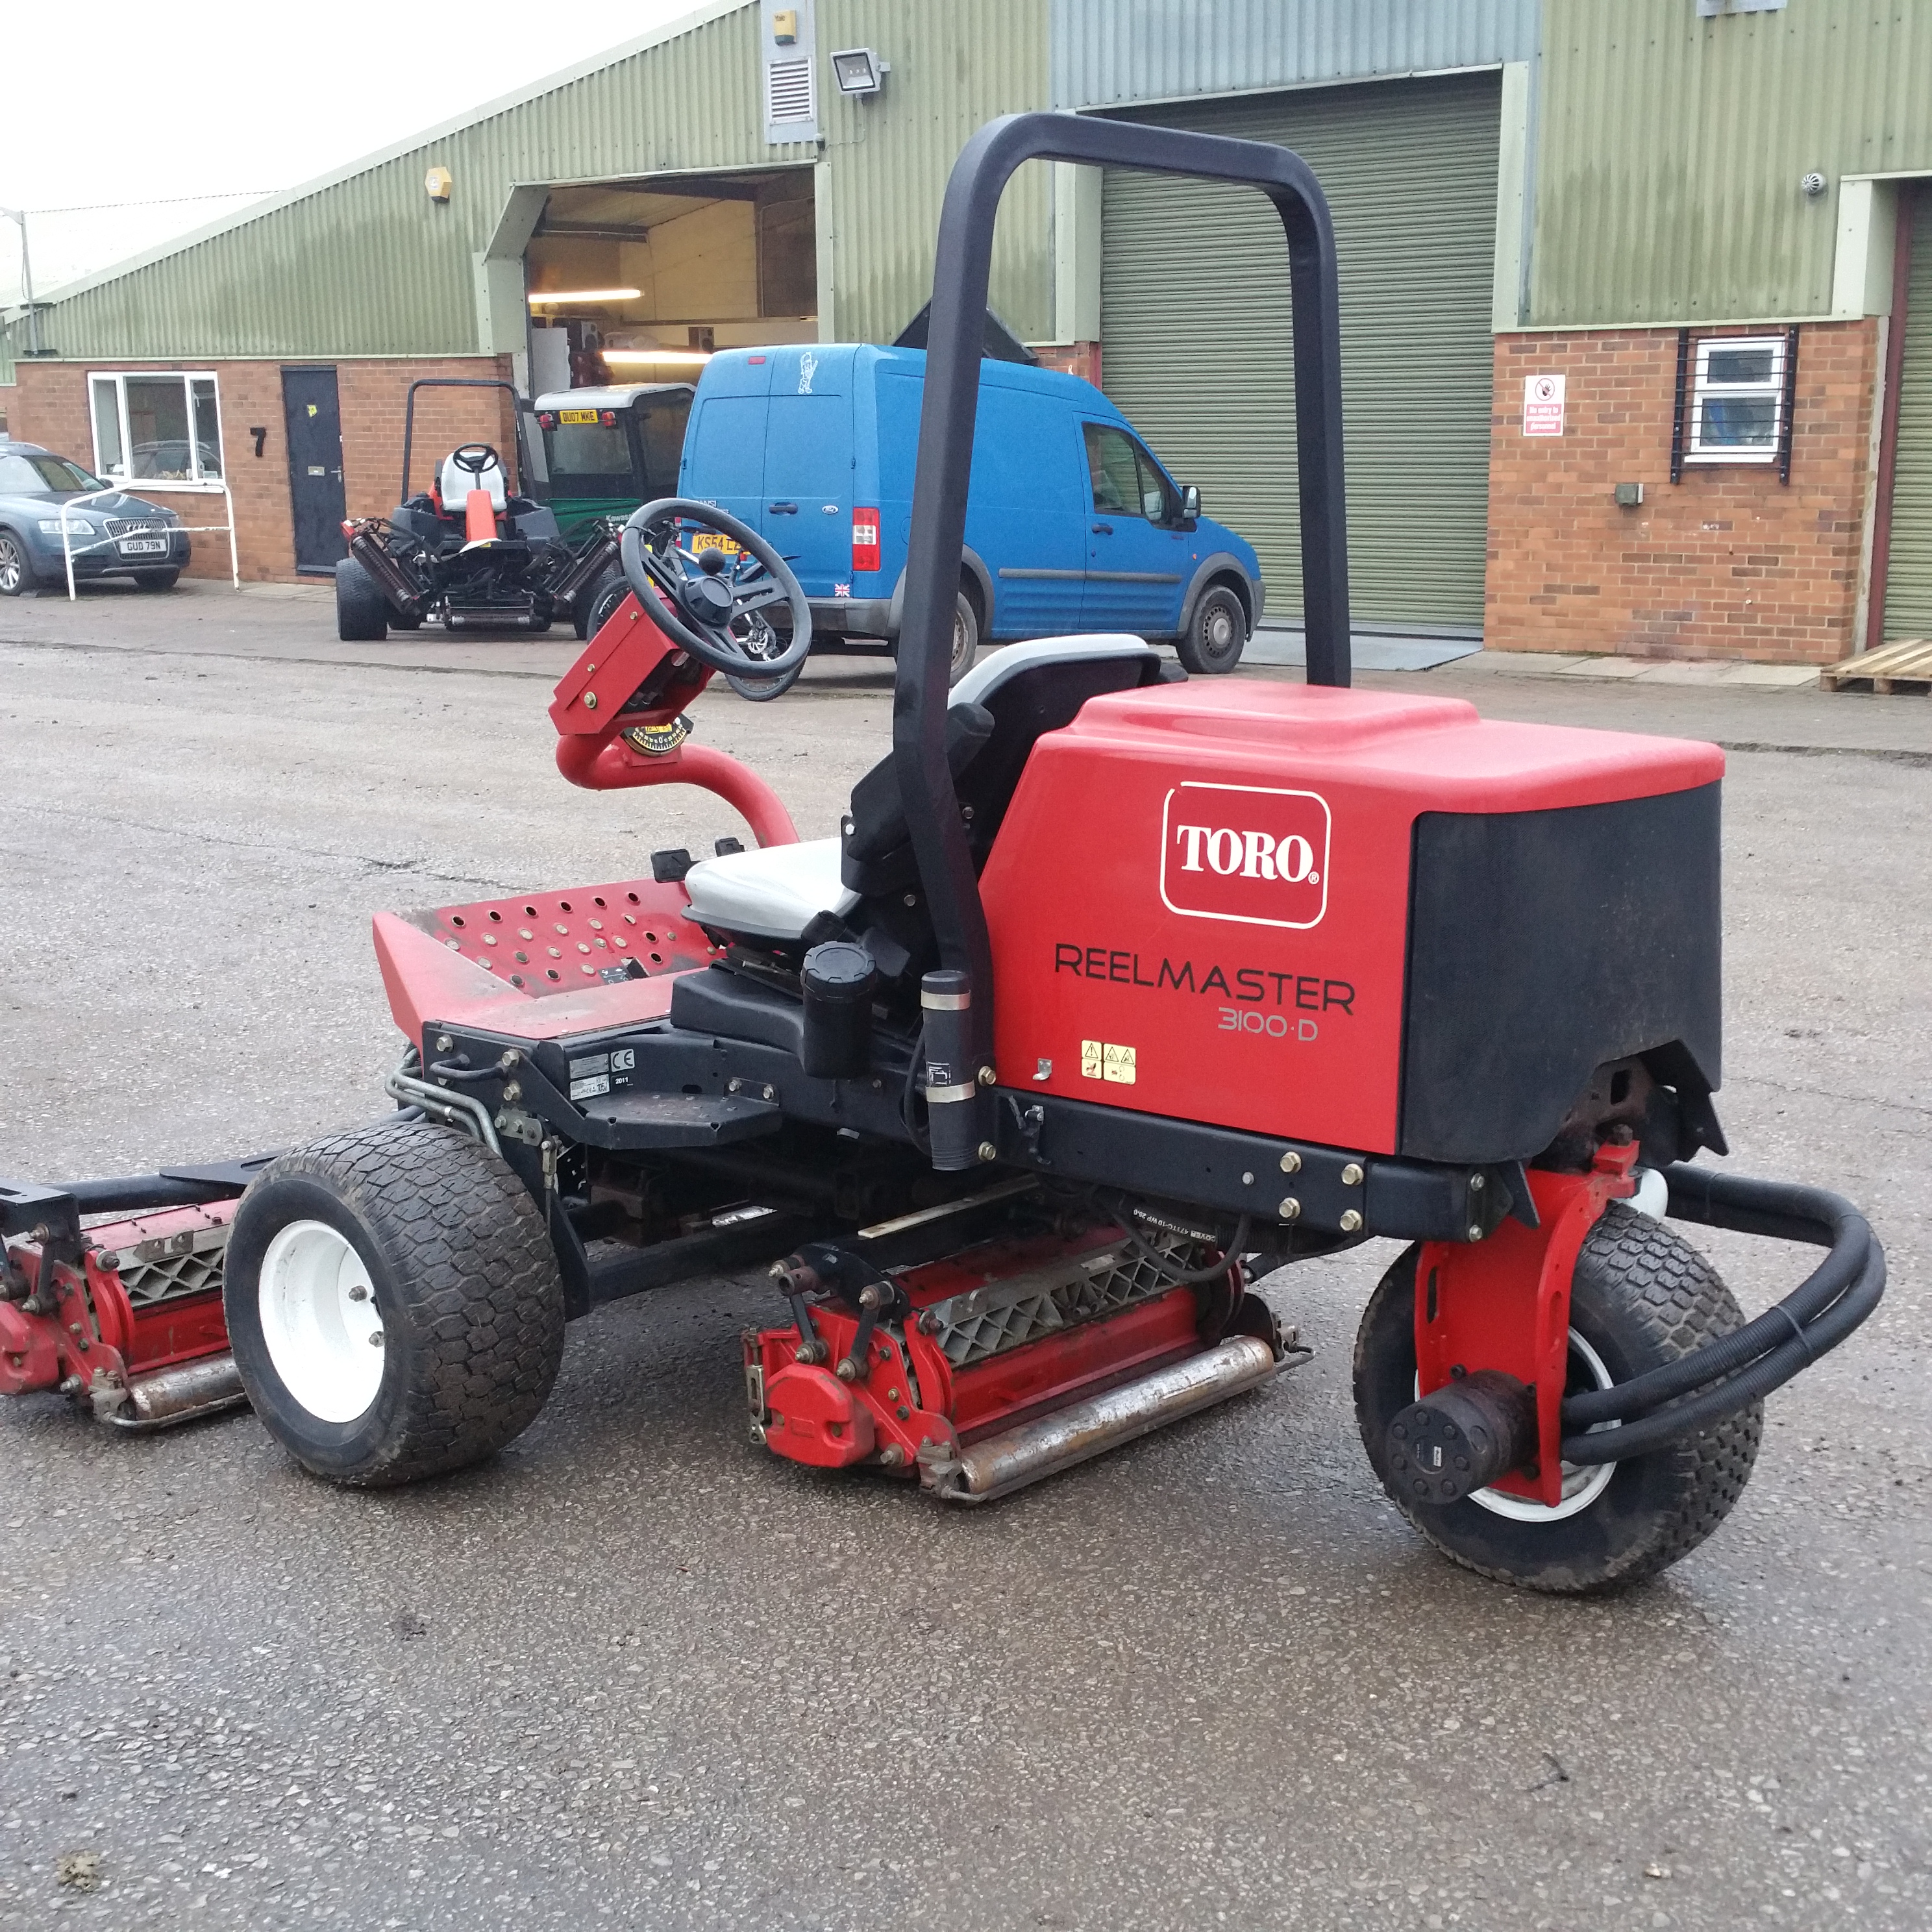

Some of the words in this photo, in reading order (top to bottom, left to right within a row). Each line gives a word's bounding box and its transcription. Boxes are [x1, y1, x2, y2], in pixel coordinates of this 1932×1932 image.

[250, 427, 267, 457] 7
[127, 541, 143, 551] GUD
[145, 541, 161, 551] 79N
[697, 536, 724, 551] KS54
[1054, 943, 1356, 1016] REELMASTER
[612, 1050, 634, 1069] CE
